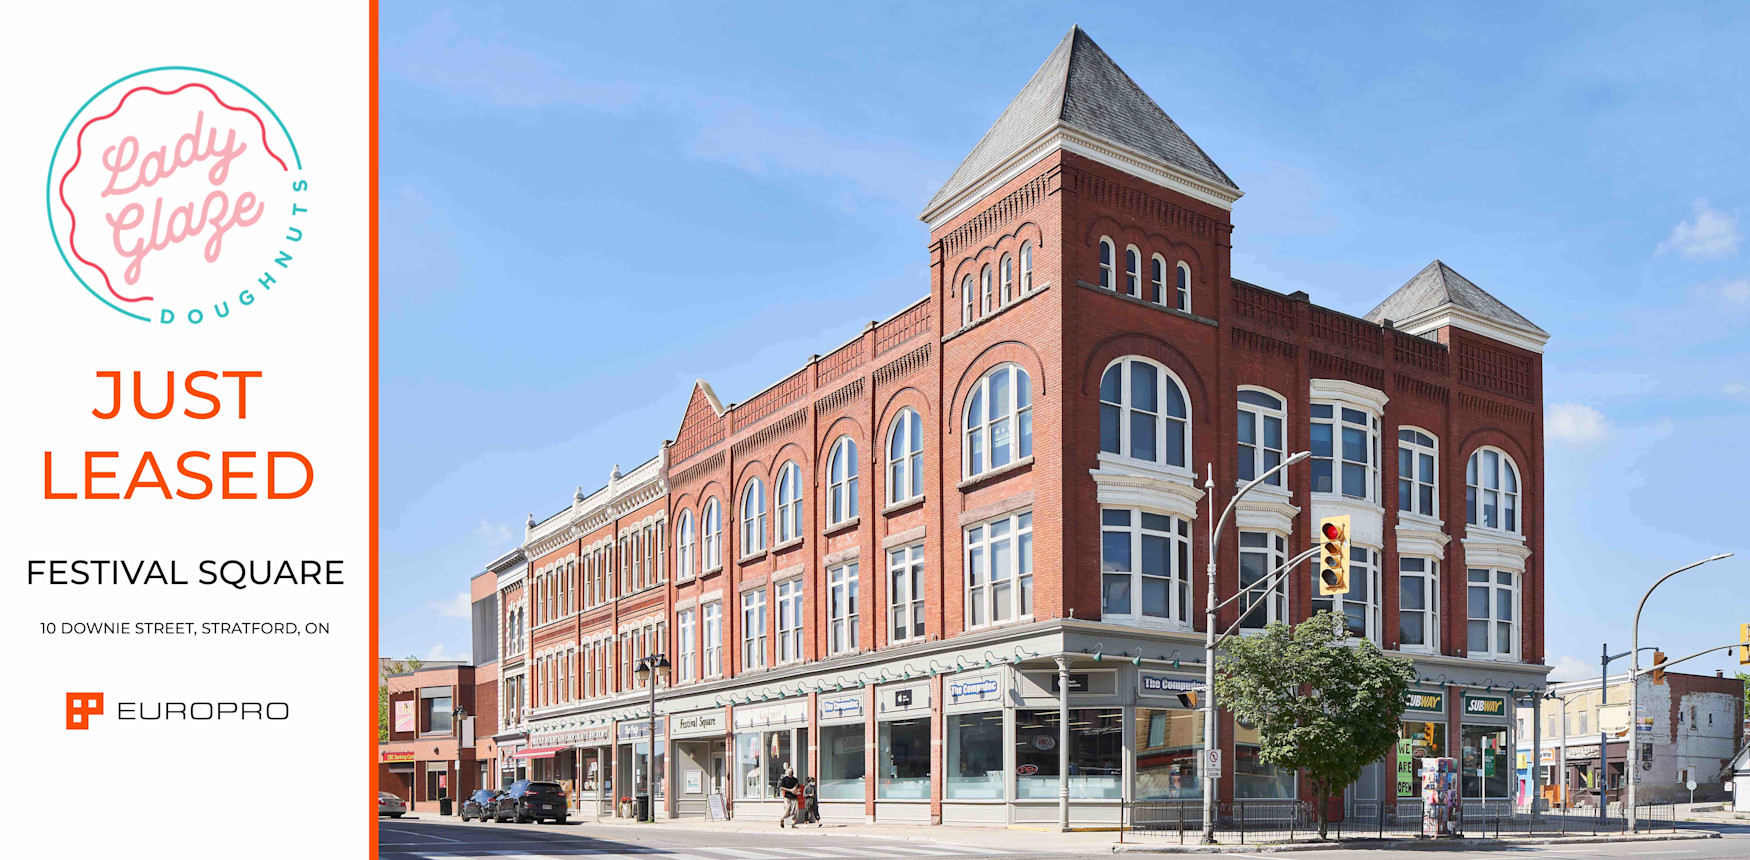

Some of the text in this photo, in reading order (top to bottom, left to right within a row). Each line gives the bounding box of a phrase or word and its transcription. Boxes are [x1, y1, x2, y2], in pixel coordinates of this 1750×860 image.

[951, 680, 997, 697] The Compudoc
[1144, 676, 1161, 689] The
[1468, 699, 1502, 712] SUBWAY
[680, 716, 716, 729] Festival Square
[1398, 742, 1410, 754] WE
[1016, 766, 1038, 774] OPEN
[1398, 761, 1412, 773] ARE
[1397, 781, 1412, 793] OPEN
